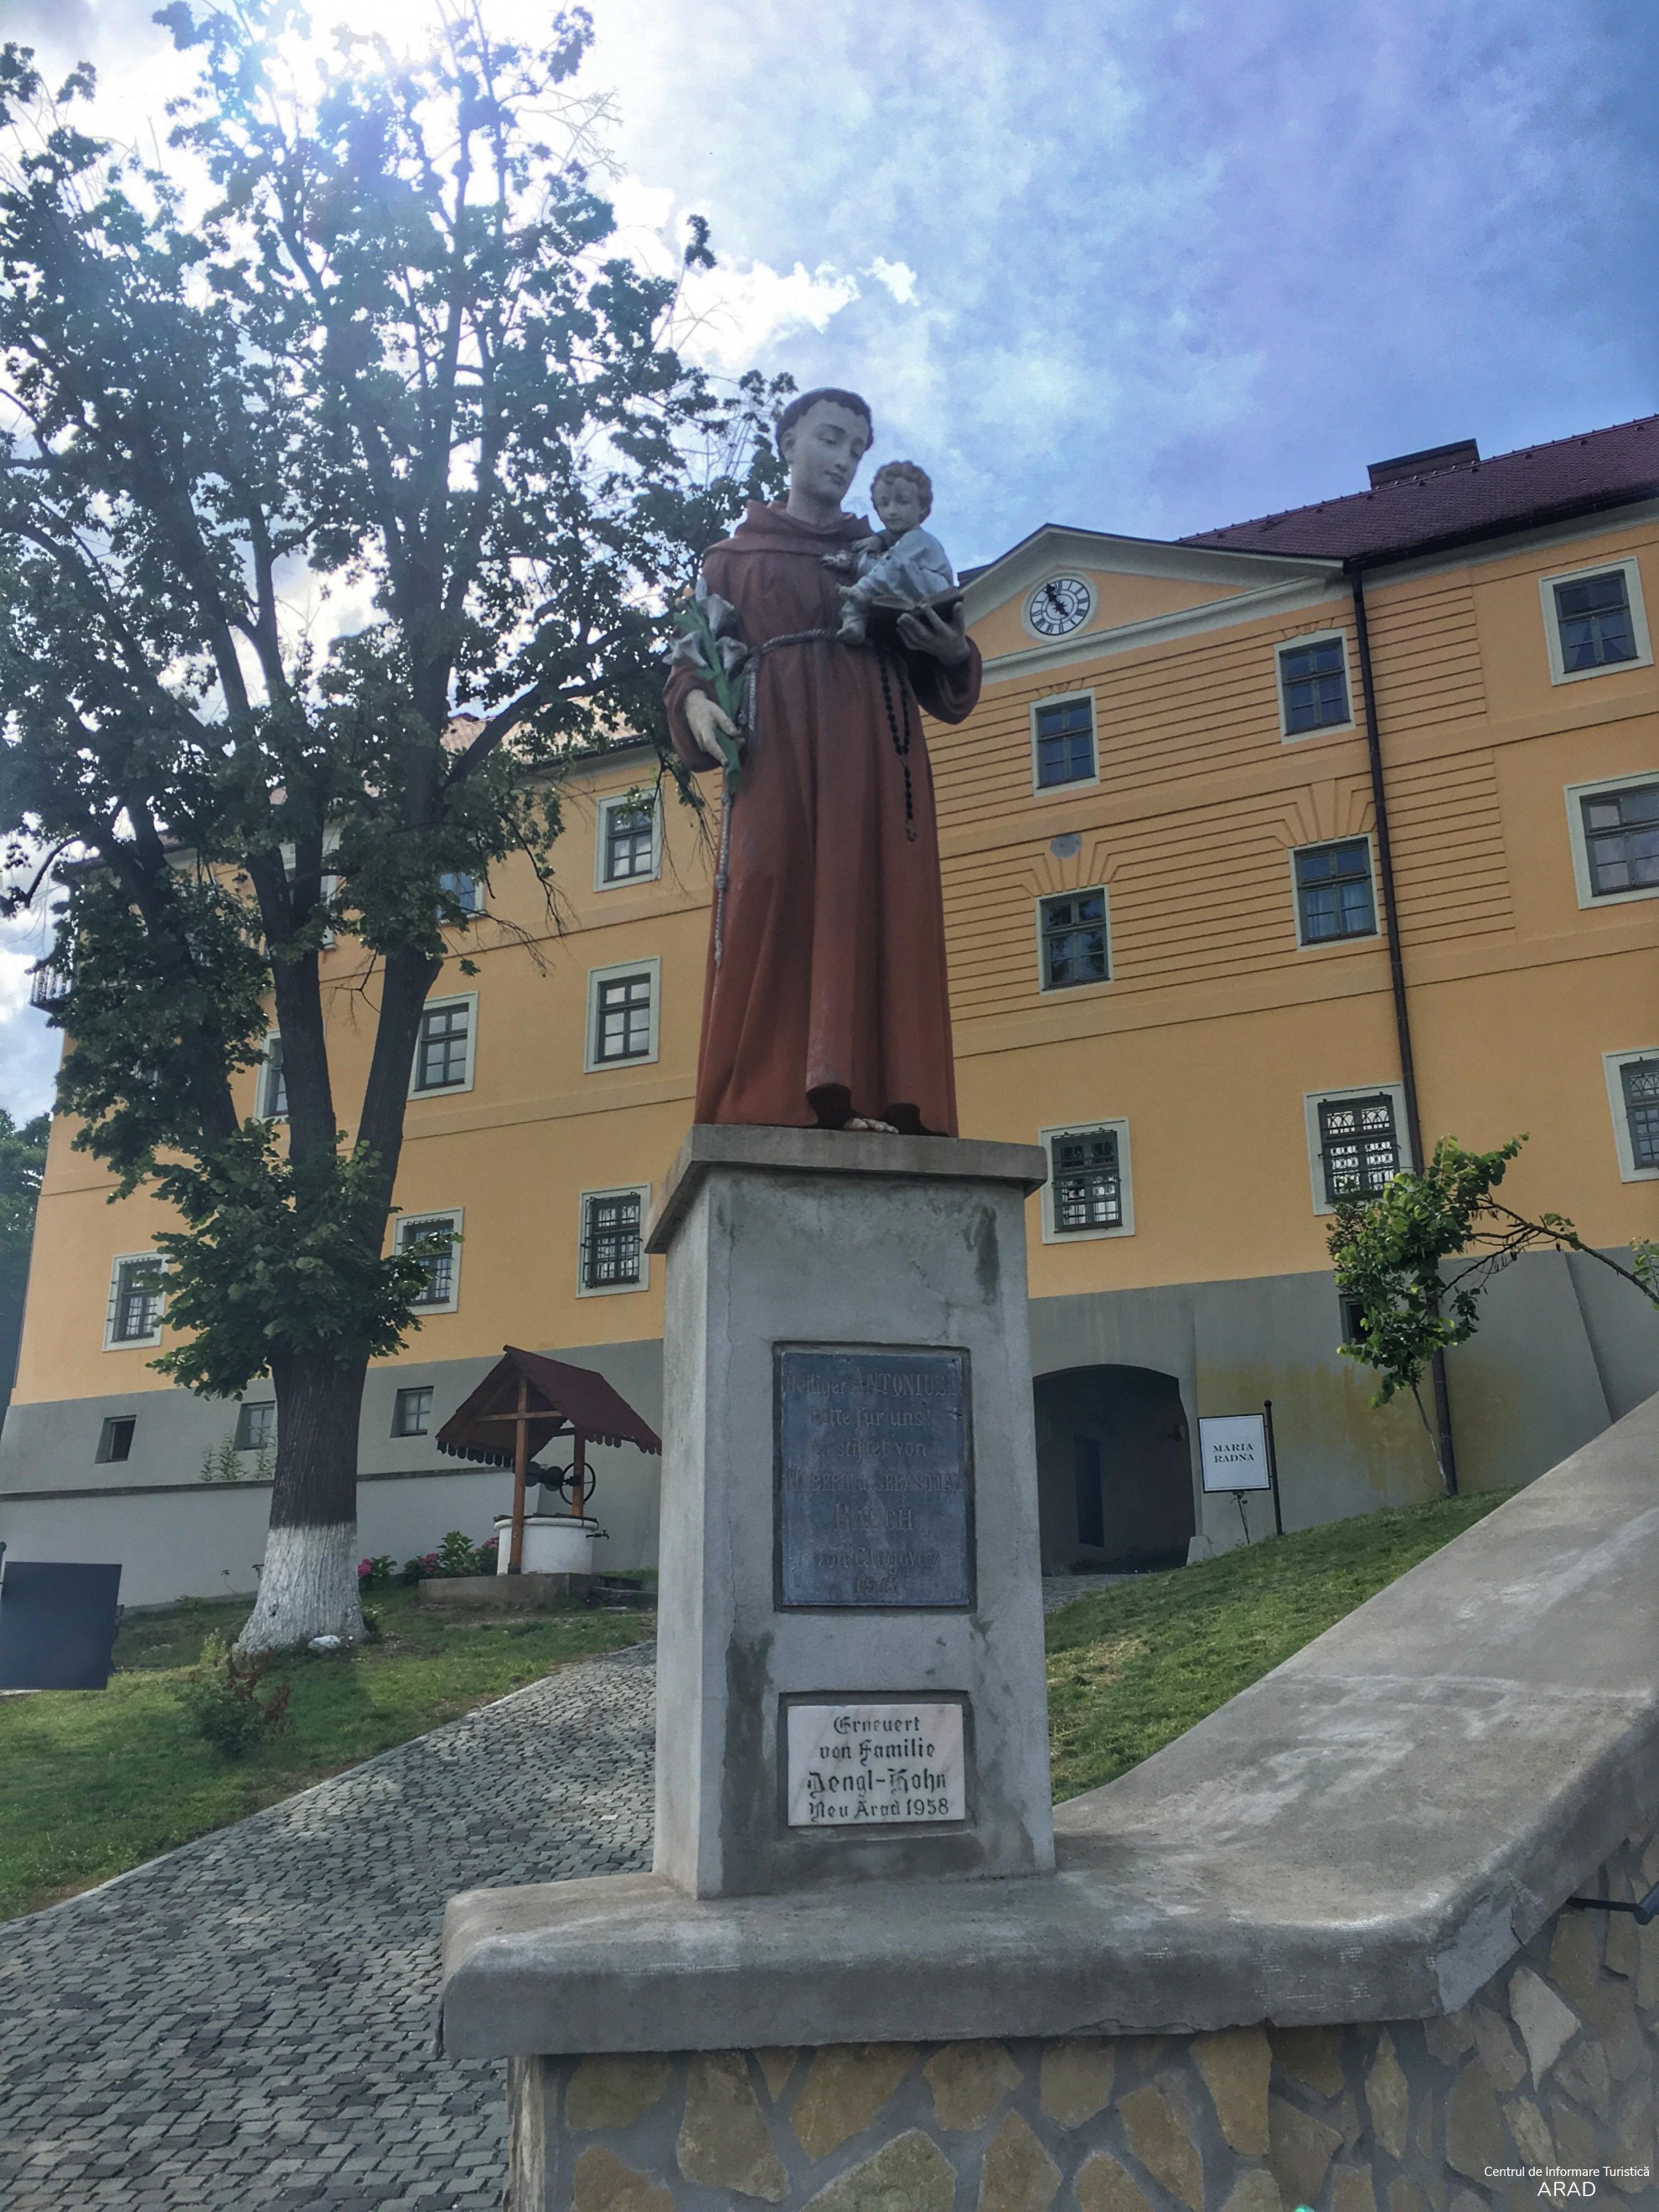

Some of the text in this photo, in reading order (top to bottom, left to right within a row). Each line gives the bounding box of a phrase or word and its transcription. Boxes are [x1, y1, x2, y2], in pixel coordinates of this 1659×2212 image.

[893, 1441, 927, 1457] von
[1212, 1443, 1253, 1453] MARIA
[1214, 1454, 1255, 1463] RADNA
[833, 1716, 920, 1734] Erneuert
[819, 1737, 935, 1766] von Familie
[809, 1798, 949, 1822] Neu Arad 1958
